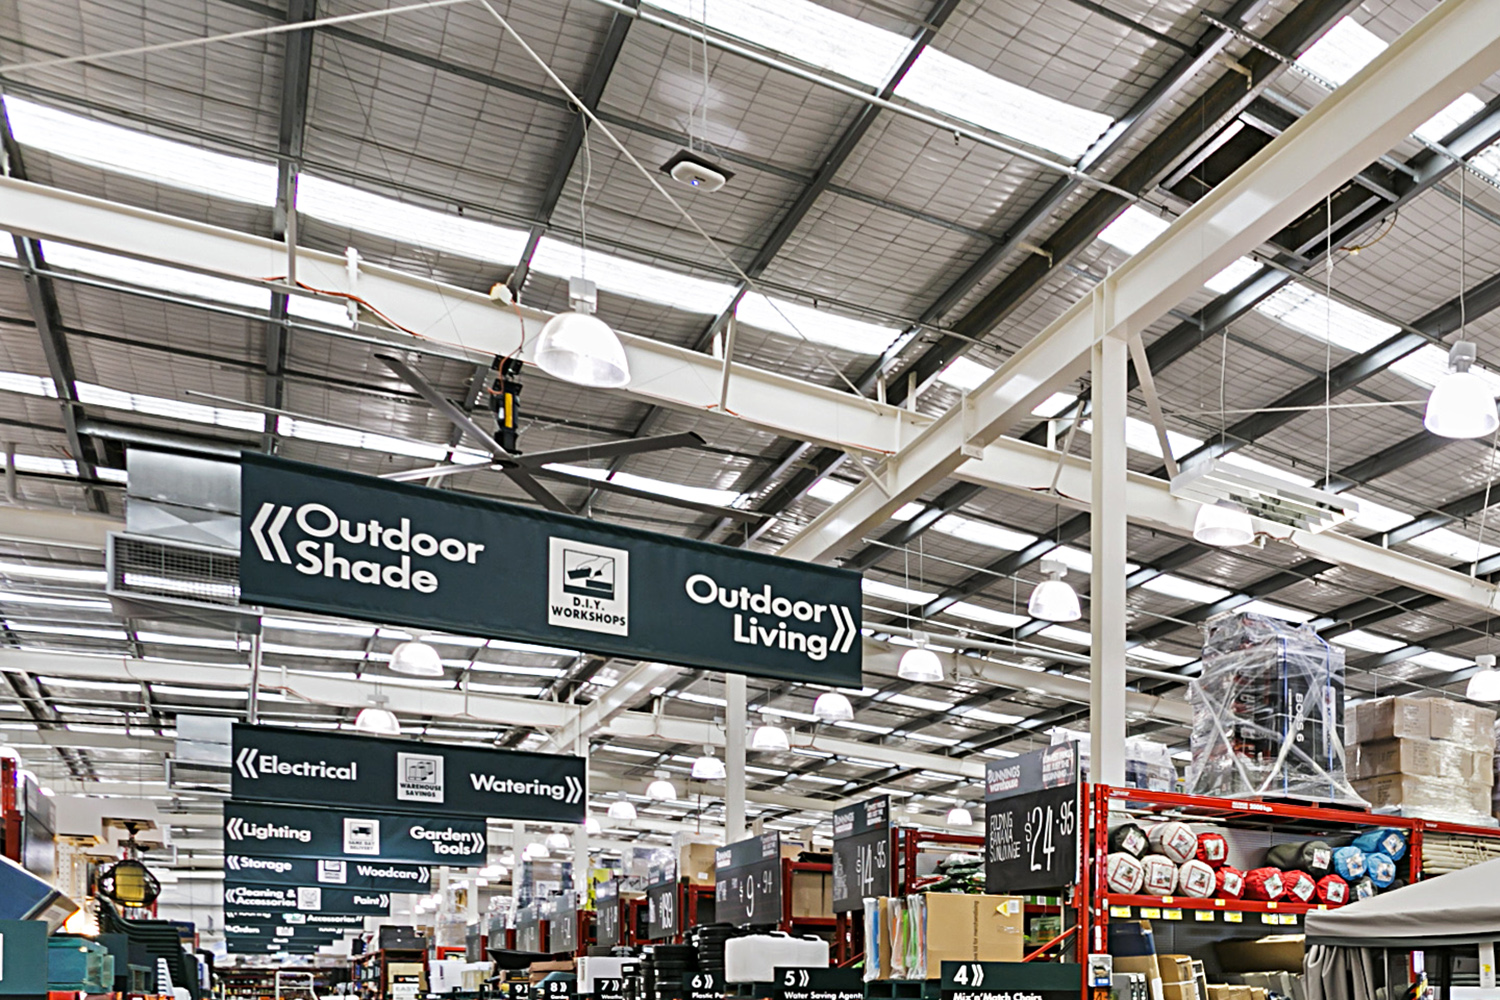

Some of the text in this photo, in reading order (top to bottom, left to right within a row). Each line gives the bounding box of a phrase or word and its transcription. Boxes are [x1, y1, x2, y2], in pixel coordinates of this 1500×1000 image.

[296, 502, 485, 566] Outdoor
[295, 541, 440, 594] Shade
[572, 596, 606, 613] D.I.Y.
[685, 574, 828, 623] Outdoor
[550, 604, 628, 628] WORKSHOPS
[733, 613, 829, 661] Living
[259, 755, 358, 781] Electrical
[987, 765, 1021, 784] BUNNINGS
[400, 783, 442, 791] WAREHOUSE
[470, 773, 566, 800] Watering
[243, 823, 312, 842] Lighting
[410, 826, 472, 843] Garden
[432, 841, 471, 856] Tools
[240, 856, 293, 872] Storage
[357, 866, 419, 880] Woodcare
[235, 887, 297, 899] Cleaning &
[353, 896, 381, 905] Paint
[235, 897, 297, 907] Accessories
[691, 975, 702, 989] 6
[784, 970, 796, 986] 5
[953, 965, 968, 985] 4
[601, 980, 610, 991] 7
[784, 991, 808, 1000] Water
[810, 991, 836, 1000] Saving
